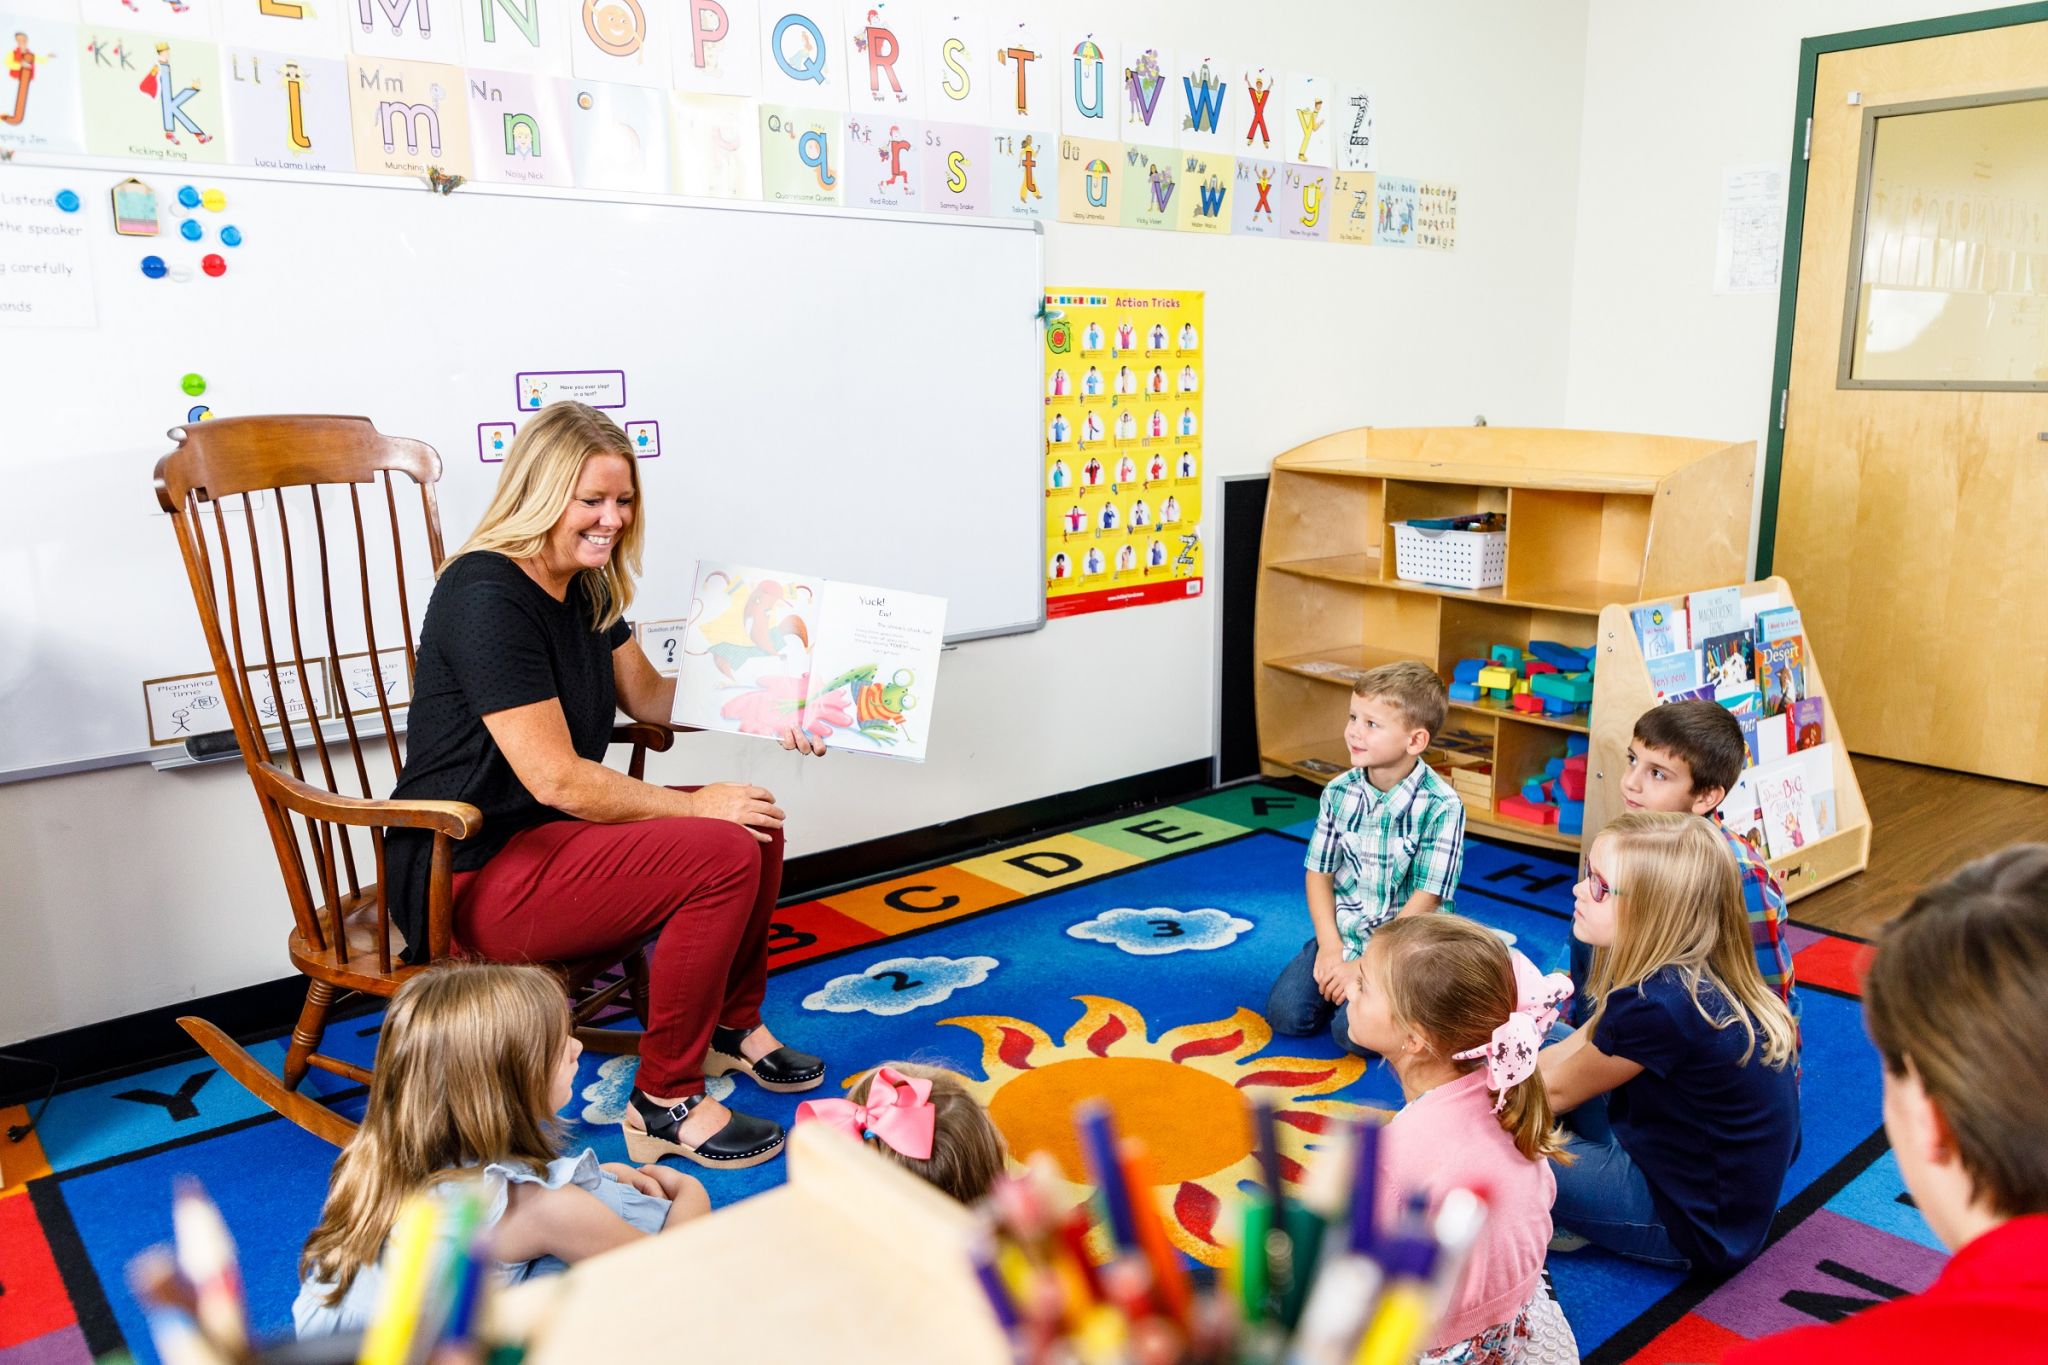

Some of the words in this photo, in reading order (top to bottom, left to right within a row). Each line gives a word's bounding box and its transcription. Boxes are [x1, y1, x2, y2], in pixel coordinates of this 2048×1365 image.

[690, 0, 730, 68] P
[771, 13, 826, 85] Q
[866, 26, 903, 93] R
[942, 38, 971, 101] S
[1007, 47, 1035, 109] T
[160, 63, 206, 134] k
[1130, 70, 1166, 127] V
[1182, 76, 1227, 135] W
[1246, 87, 1270, 142] X
[381, 101, 441, 149] m
[503, 113, 541, 157] n
[128, 145, 164, 160] Kicking
[166, 149, 188, 161] King
[385, 161, 424, 173] Munching
[798, 131, 836, 186] q
[890, 140, 911, 176] r
[505, 169, 526, 181] Noisy
[527, 171, 544, 181] Nick
[946, 151, 968, 193] s
[1022, 151, 1036, 193] t
[1, 192, 55, 207] Listene
[882, 198, 898, 207] Robot
[940, 202, 959, 211] Sammy
[960, 203, 974, 211] Snake
[1086, 174, 1108, 208] u
[1154, 181, 1175, 213] v
[1199, 185, 1227, 217] w
[28, 224, 83, 237] speaker
[11, 262, 73, 278] carefully
[1115, 296, 1149, 308] Action
[1151, 297, 1181, 308] Tricks
[858, 594, 886, 608] Yuck!
[1763, 645, 1800, 665] Desert
[157, 681, 213, 692] Planning
[1122, 819, 1204, 844] E
[1003, 852, 1083, 879] D
[1482, 862, 1573, 894] H
[884, 885, 960, 914] C
[1147, 919, 1185, 938] 3
[873, 970, 924, 993] 2
[111, 1068, 219, 1122] Y
